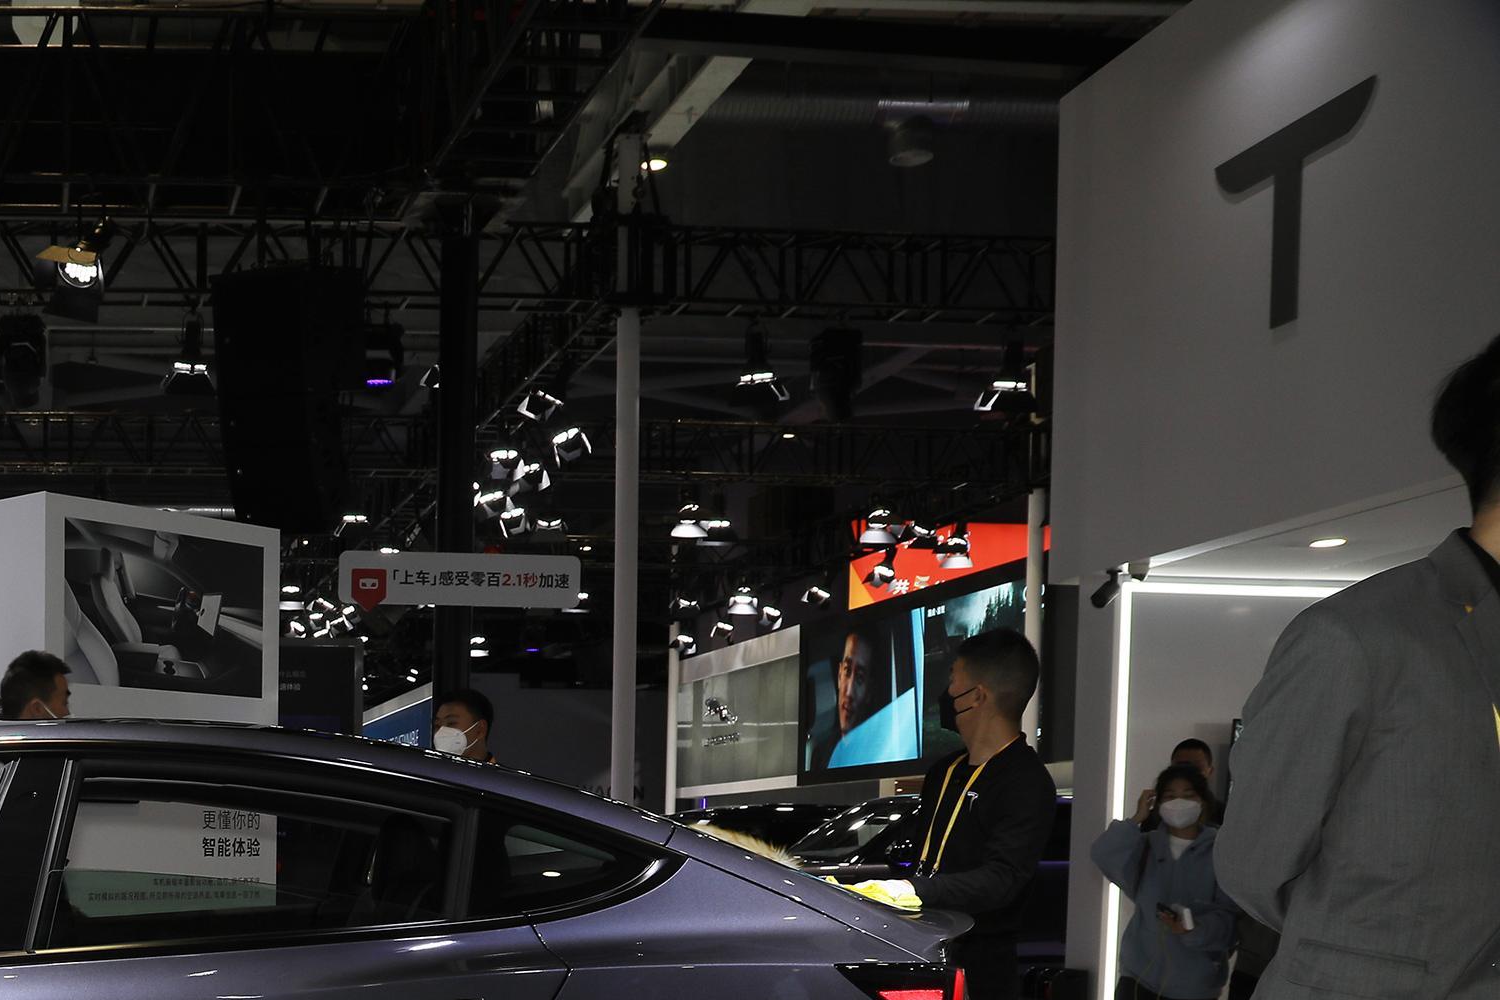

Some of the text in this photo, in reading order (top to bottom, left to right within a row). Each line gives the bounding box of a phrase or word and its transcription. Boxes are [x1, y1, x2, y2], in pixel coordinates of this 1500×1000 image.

[393, 569, 571, 589] 「上车」感受零百2.1秒加速
[202, 810, 261, 831] 更懂你的
[202, 837, 261, 858] 智能体验
